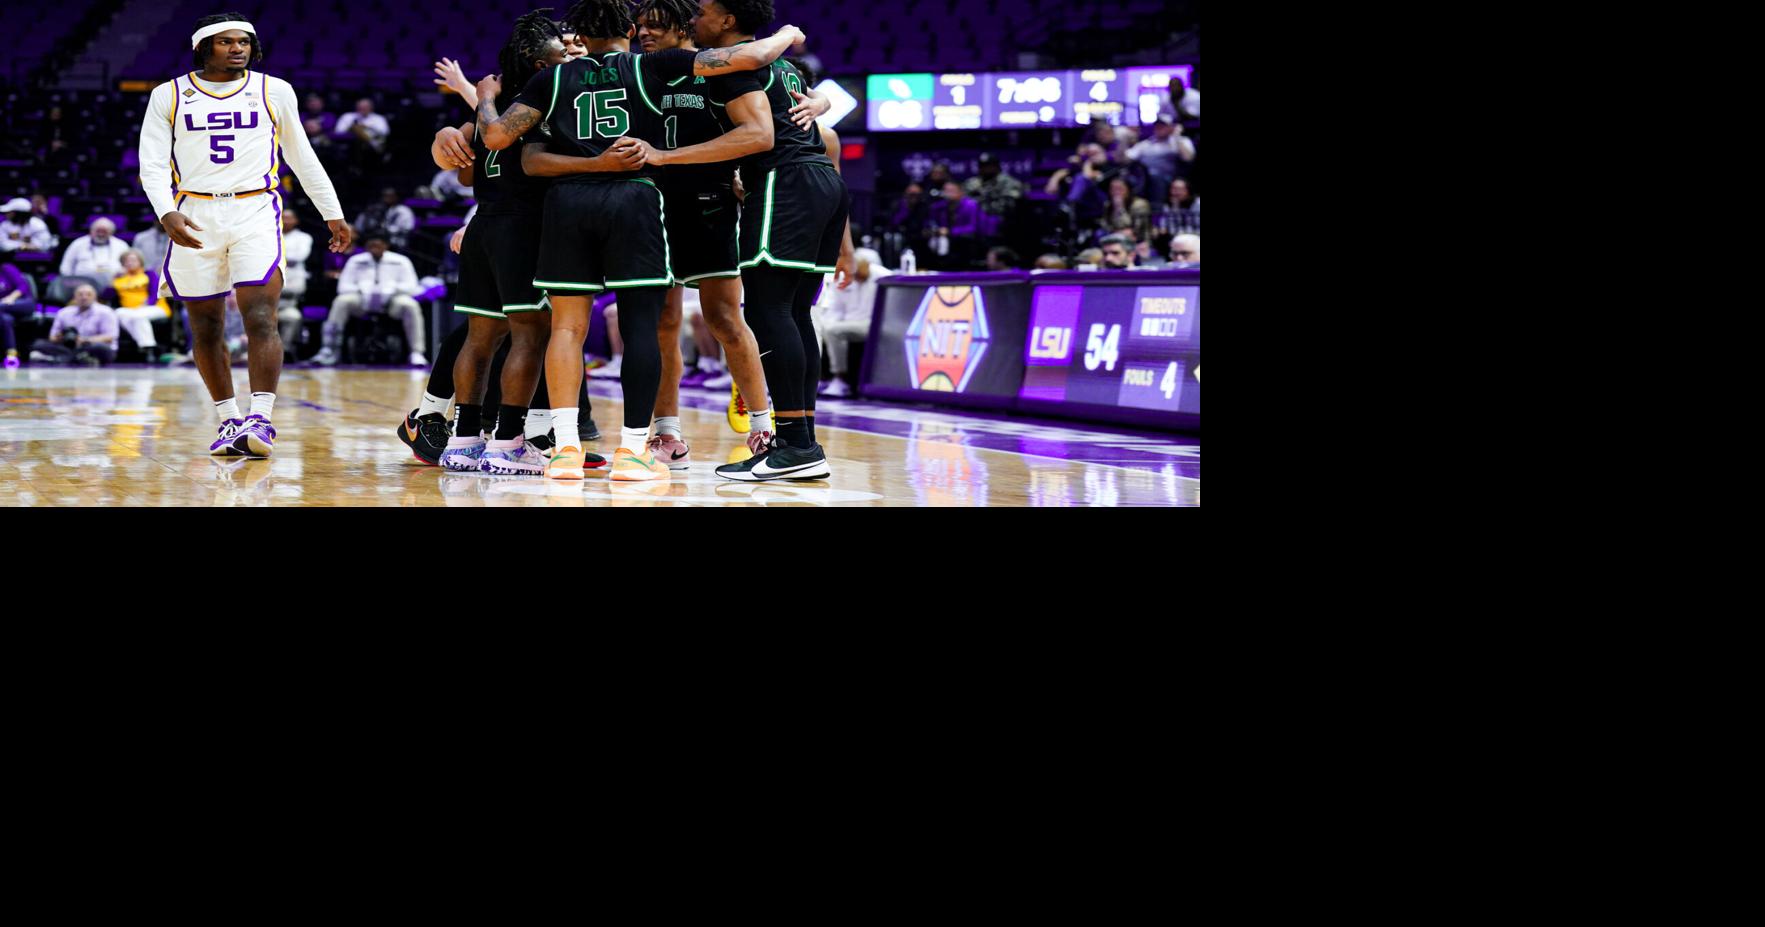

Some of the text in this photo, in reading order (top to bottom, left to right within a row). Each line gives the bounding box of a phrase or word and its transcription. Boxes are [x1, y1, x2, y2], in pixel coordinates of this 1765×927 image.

[579, 67, 619, 85] JOES
[574, 88, 630, 139] 15
[673, 94, 705, 109] TEXAS
[184, 111, 258, 131] LSU
[664, 115, 677, 149] 1
[210, 135, 235, 164] 5
[922, 319, 970, 358] NIT
[1084, 323, 1121, 371] 54
[1160, 361, 1178, 399] 4
